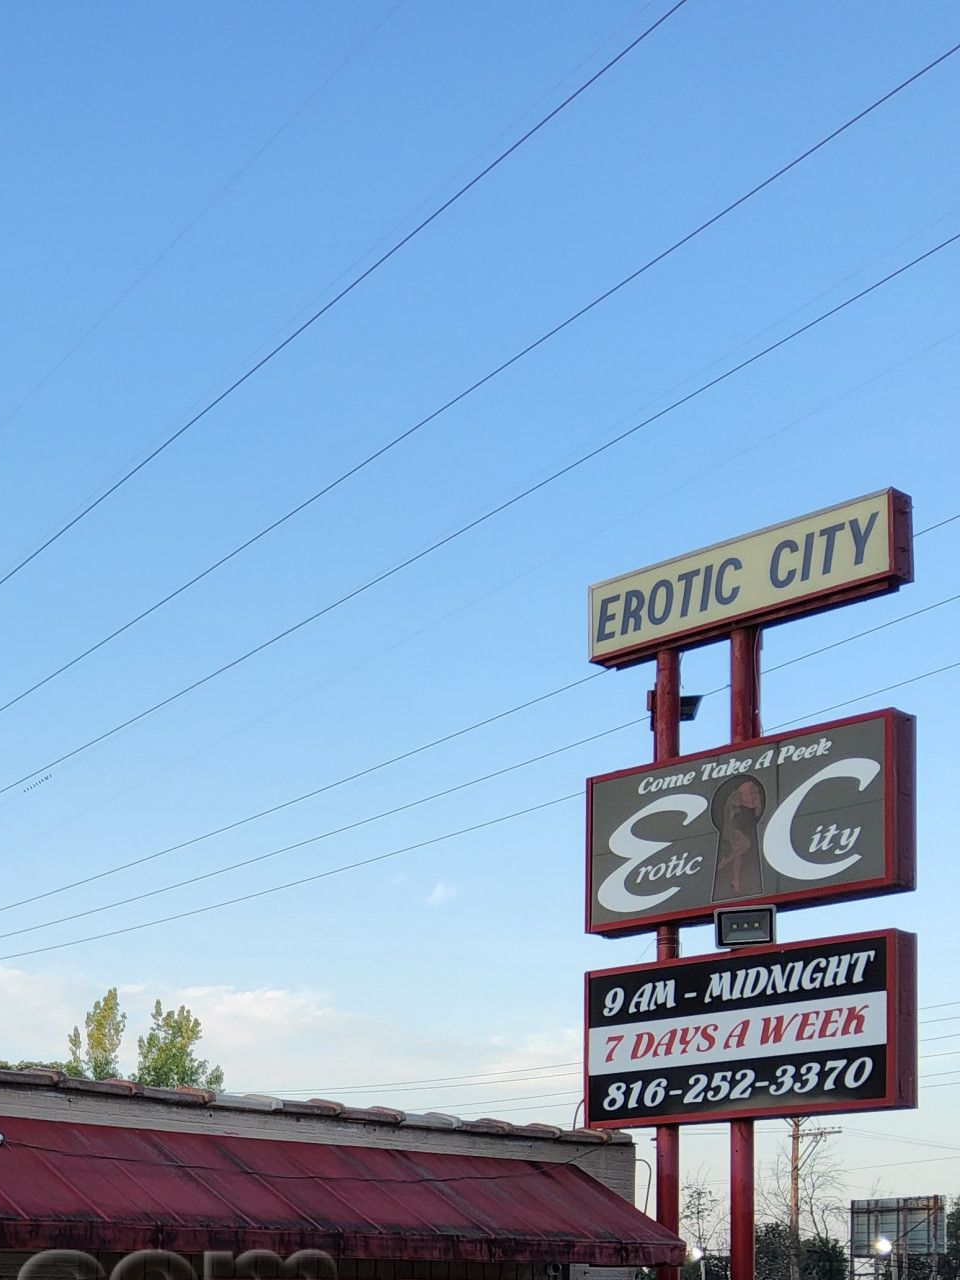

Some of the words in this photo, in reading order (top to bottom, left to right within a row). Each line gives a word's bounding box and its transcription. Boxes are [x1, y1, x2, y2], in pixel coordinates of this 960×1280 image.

[595, 556, 743, 644] EROTIC
[768, 510, 880, 589] CITY
[637, 772, 696, 796] Come
[700, 755, 753, 783] Take
[755, 748, 774, 769] A
[776, 737, 833, 766] Peek
[602, 986, 626, 1017] 9
[628, 978, 677, 1015] AM
[704, 949, 876, 1004] MIDNIGHT
[604, 1034, 625, 1064] 7
[630, 1022, 720, 1061] DAYS
[723, 1018, 751, 1049] A
[759, 1003, 870, 1046] WEEK
[602, 1056, 874, 1112] 816-252-3370
